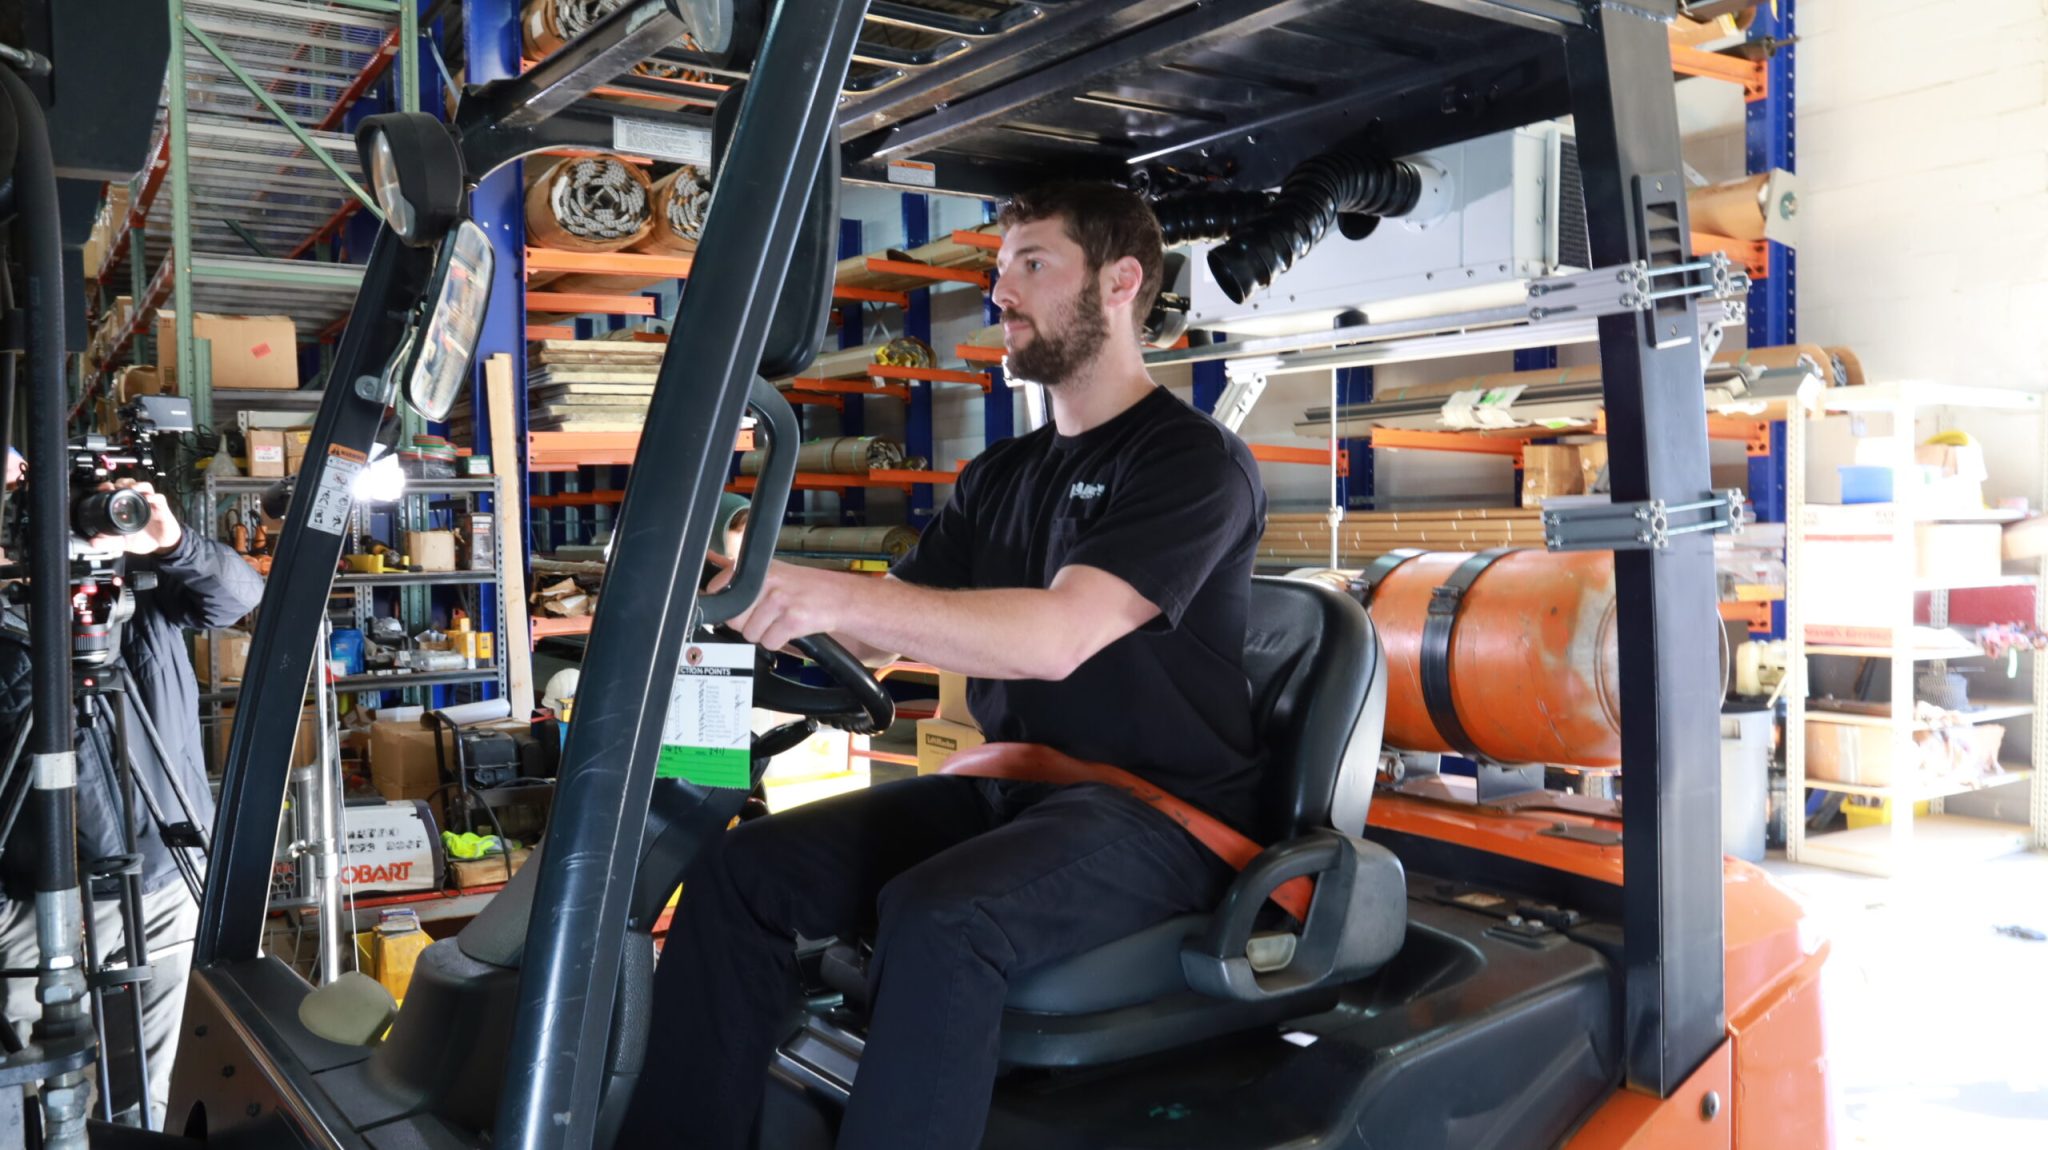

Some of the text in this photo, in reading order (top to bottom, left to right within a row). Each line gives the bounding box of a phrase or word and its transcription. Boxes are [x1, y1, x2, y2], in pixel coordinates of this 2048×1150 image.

[680, 667, 731, 676] CTION POINTS
[341, 862, 413, 884] OBART
